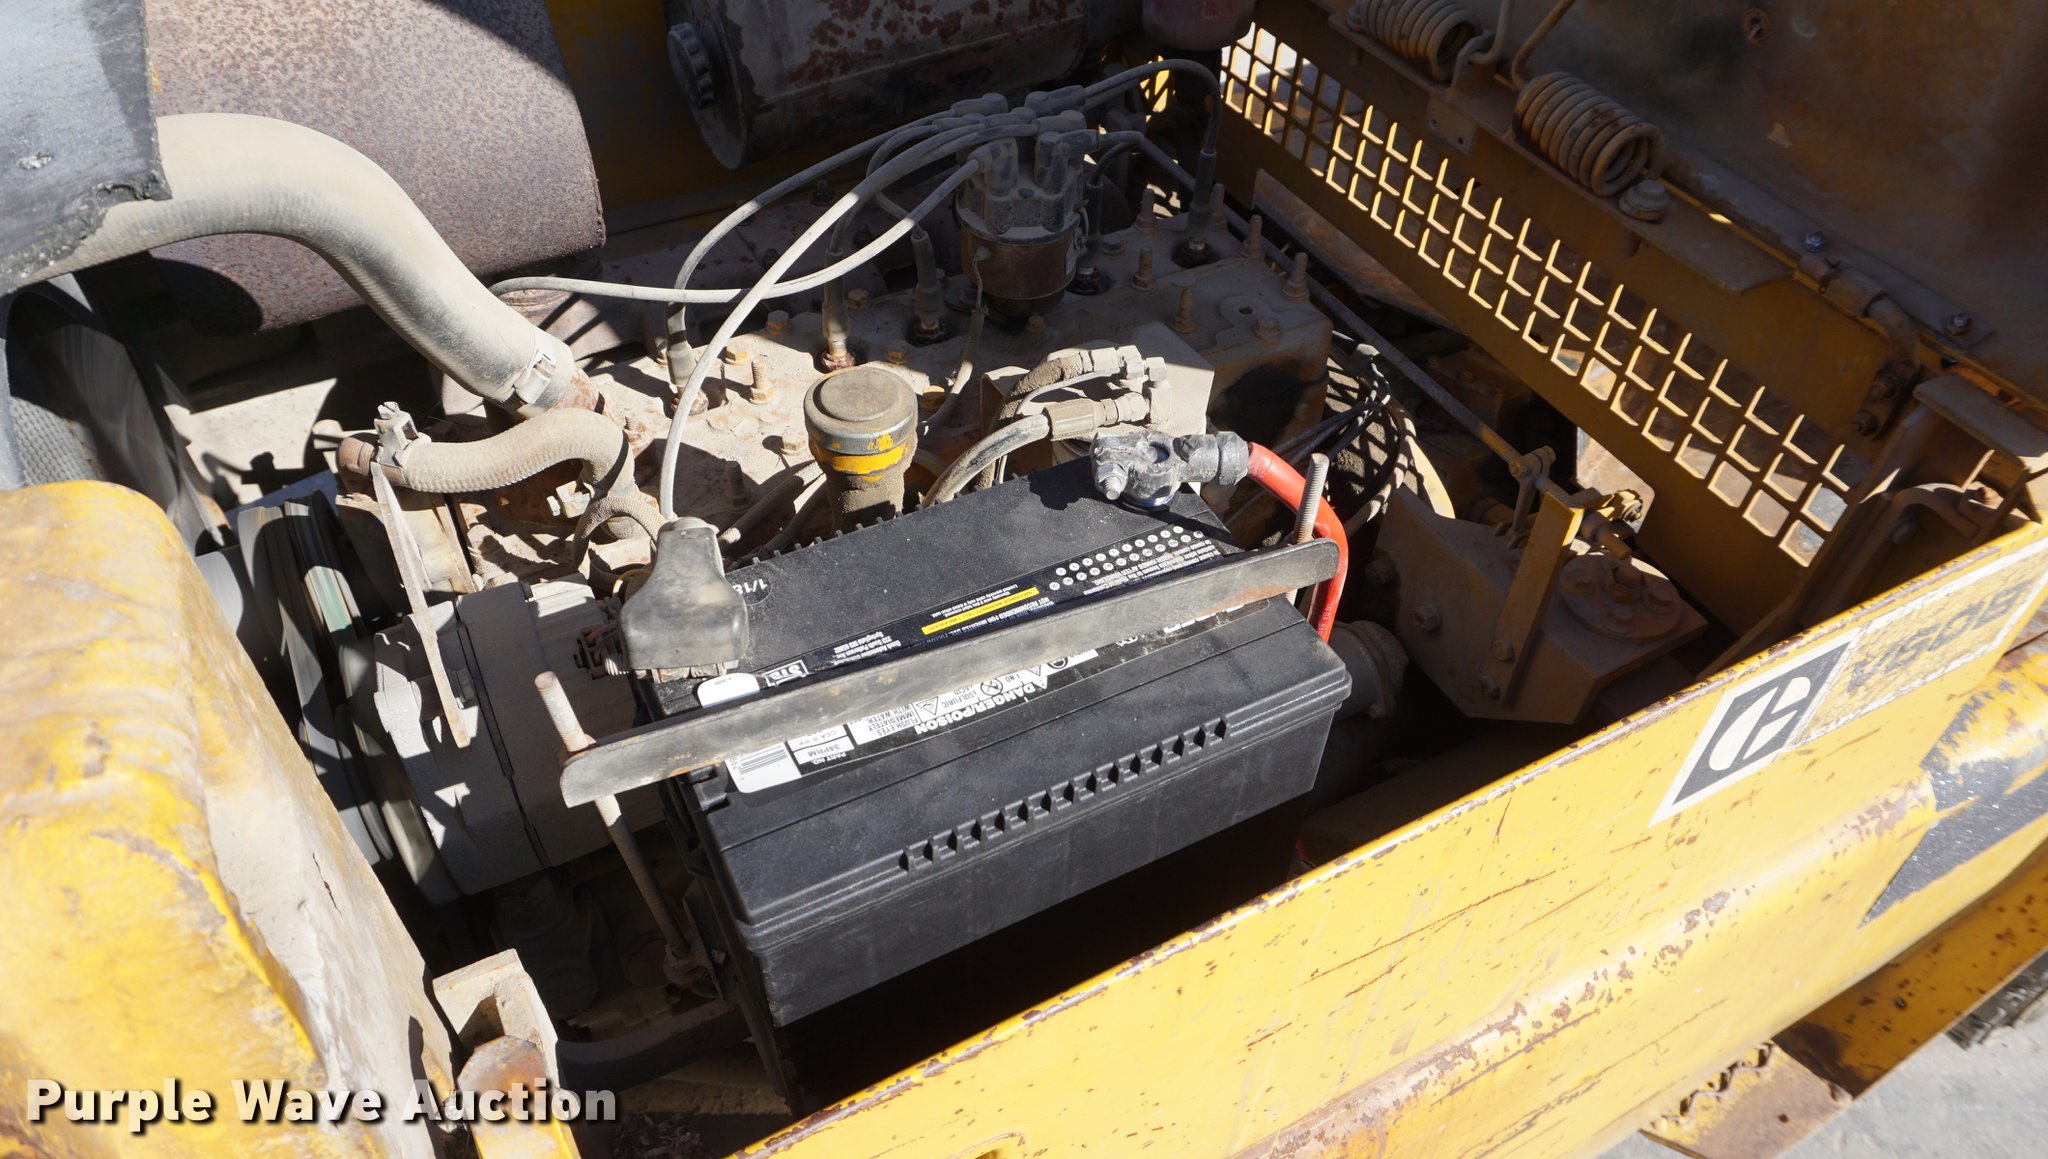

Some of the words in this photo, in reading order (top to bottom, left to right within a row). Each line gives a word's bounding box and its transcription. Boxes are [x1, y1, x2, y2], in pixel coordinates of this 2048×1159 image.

[940, 691, 974, 708] SULFURIC
[892, 703, 911, 714] WITH
[912, 682, 1037, 734] DANGER/POISON
[864, 711, 891, 725] WATER.
[867, 710, 914, 731] IMMEDIATELY
[895, 717, 918, 729] FLUSH
[876, 725, 895, 736] EYES
[806, 742, 840, 758] 34PRM
[825, 751, 846, 762] PART
